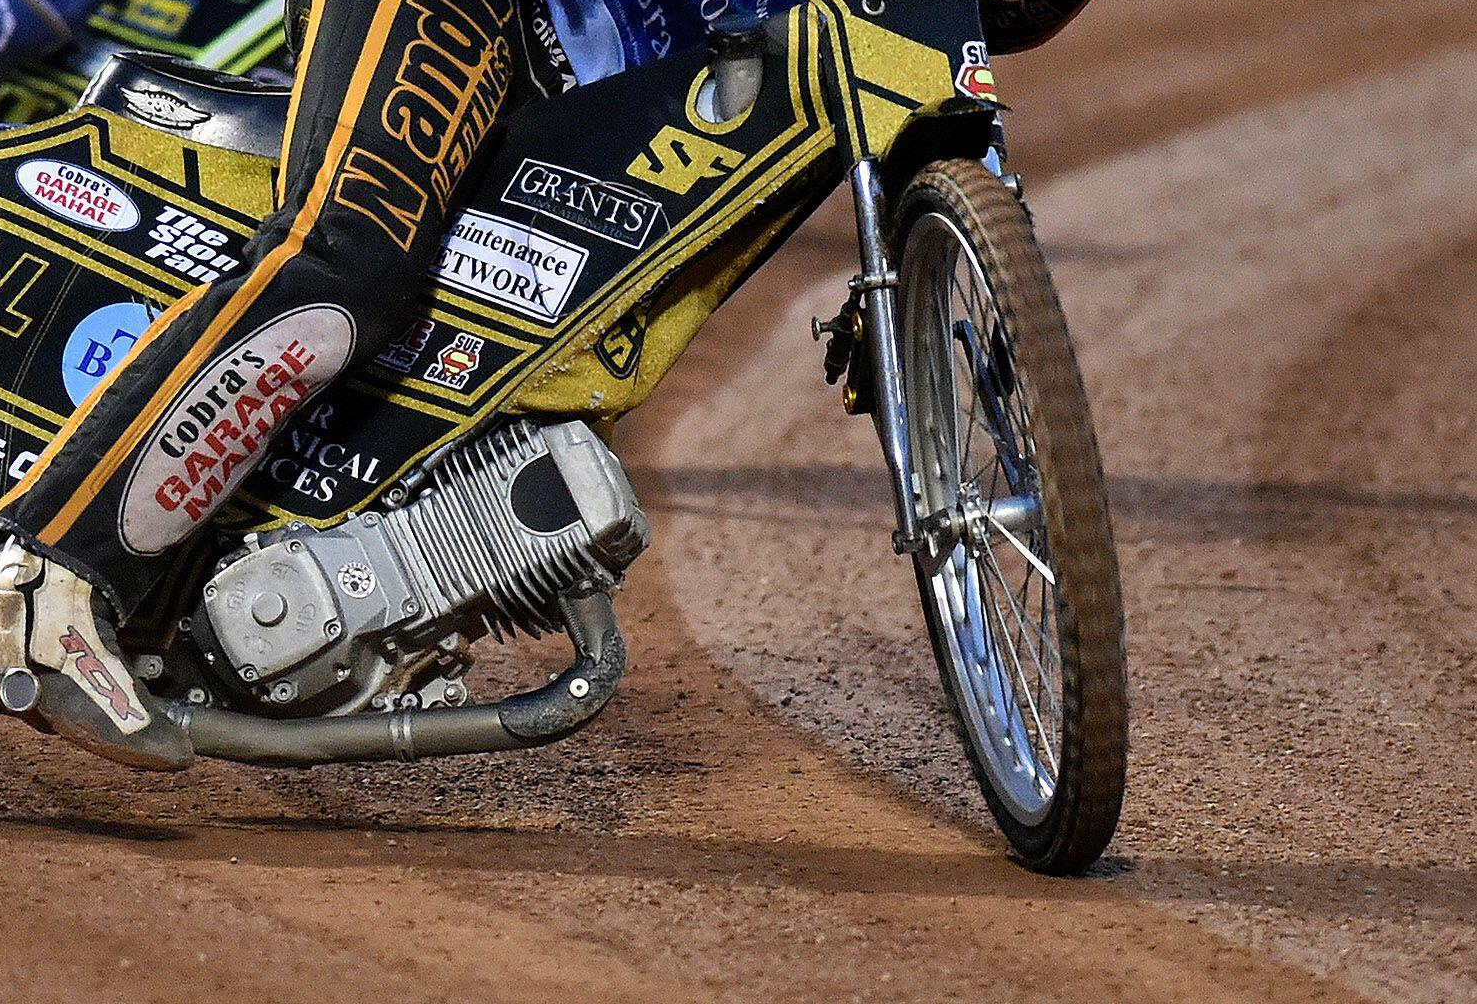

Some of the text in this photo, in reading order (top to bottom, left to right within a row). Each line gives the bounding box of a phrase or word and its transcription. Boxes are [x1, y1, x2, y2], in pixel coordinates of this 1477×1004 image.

[34, 185, 109, 226] MAHAL
[36, 171, 123, 217] GARAGE
[57, 165, 113, 197] Cobra's
[334, 146, 428, 253] N
[520, 165, 648, 233] GRANTS
[155, 205, 229, 247] The
[450, 221, 569, 277] aintenance
[144, 243, 221, 284] Fan
[435, 248, 555, 309] ETWORK
[454, 334, 482, 354] SUE
[154, 339, 316, 513] GARAGE
[159, 348, 266, 459] Cobra's
[182, 379, 320, 523] MAHAL
